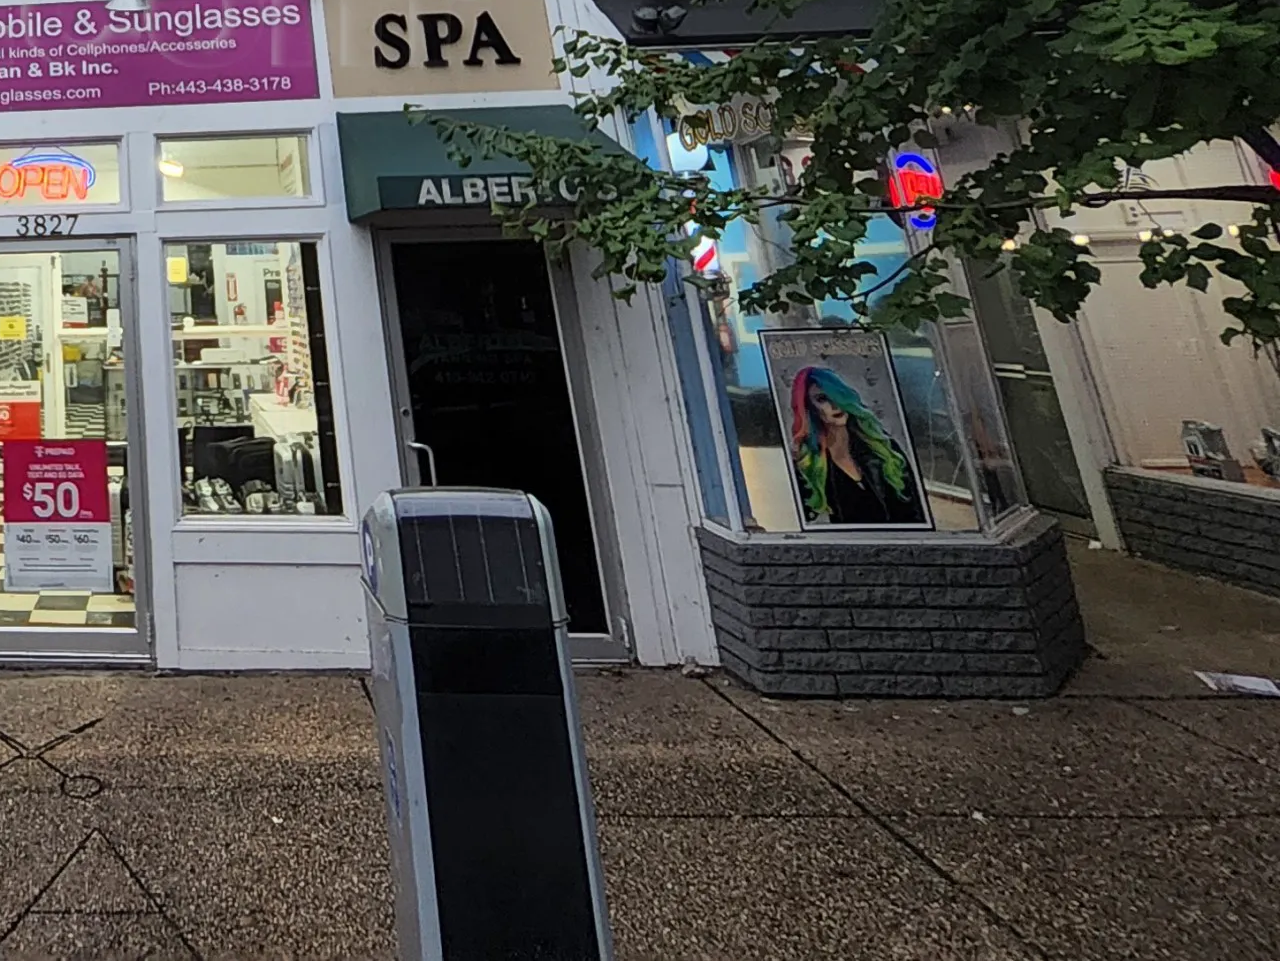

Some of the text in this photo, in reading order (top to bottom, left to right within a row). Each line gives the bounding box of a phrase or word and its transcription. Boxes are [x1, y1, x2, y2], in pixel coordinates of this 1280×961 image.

[74, 9, 97, 35] &
[108, 3, 301, 37] Sunglasses
[8, 46, 46, 60] kinds
[50, 45, 64, 57] of
[66, 38, 237, 58] Cellphones/Accessories
[374, 11, 521, 70] SPA
[27, 62, 43, 78] &
[48, 62, 76, 77] Bk
[82, 60, 119, 76] Inc.
[148, 76, 292, 96] Ph:443-438-3178
[16, 214, 79, 237] 3827
[23, 481, 80, 518] $50
